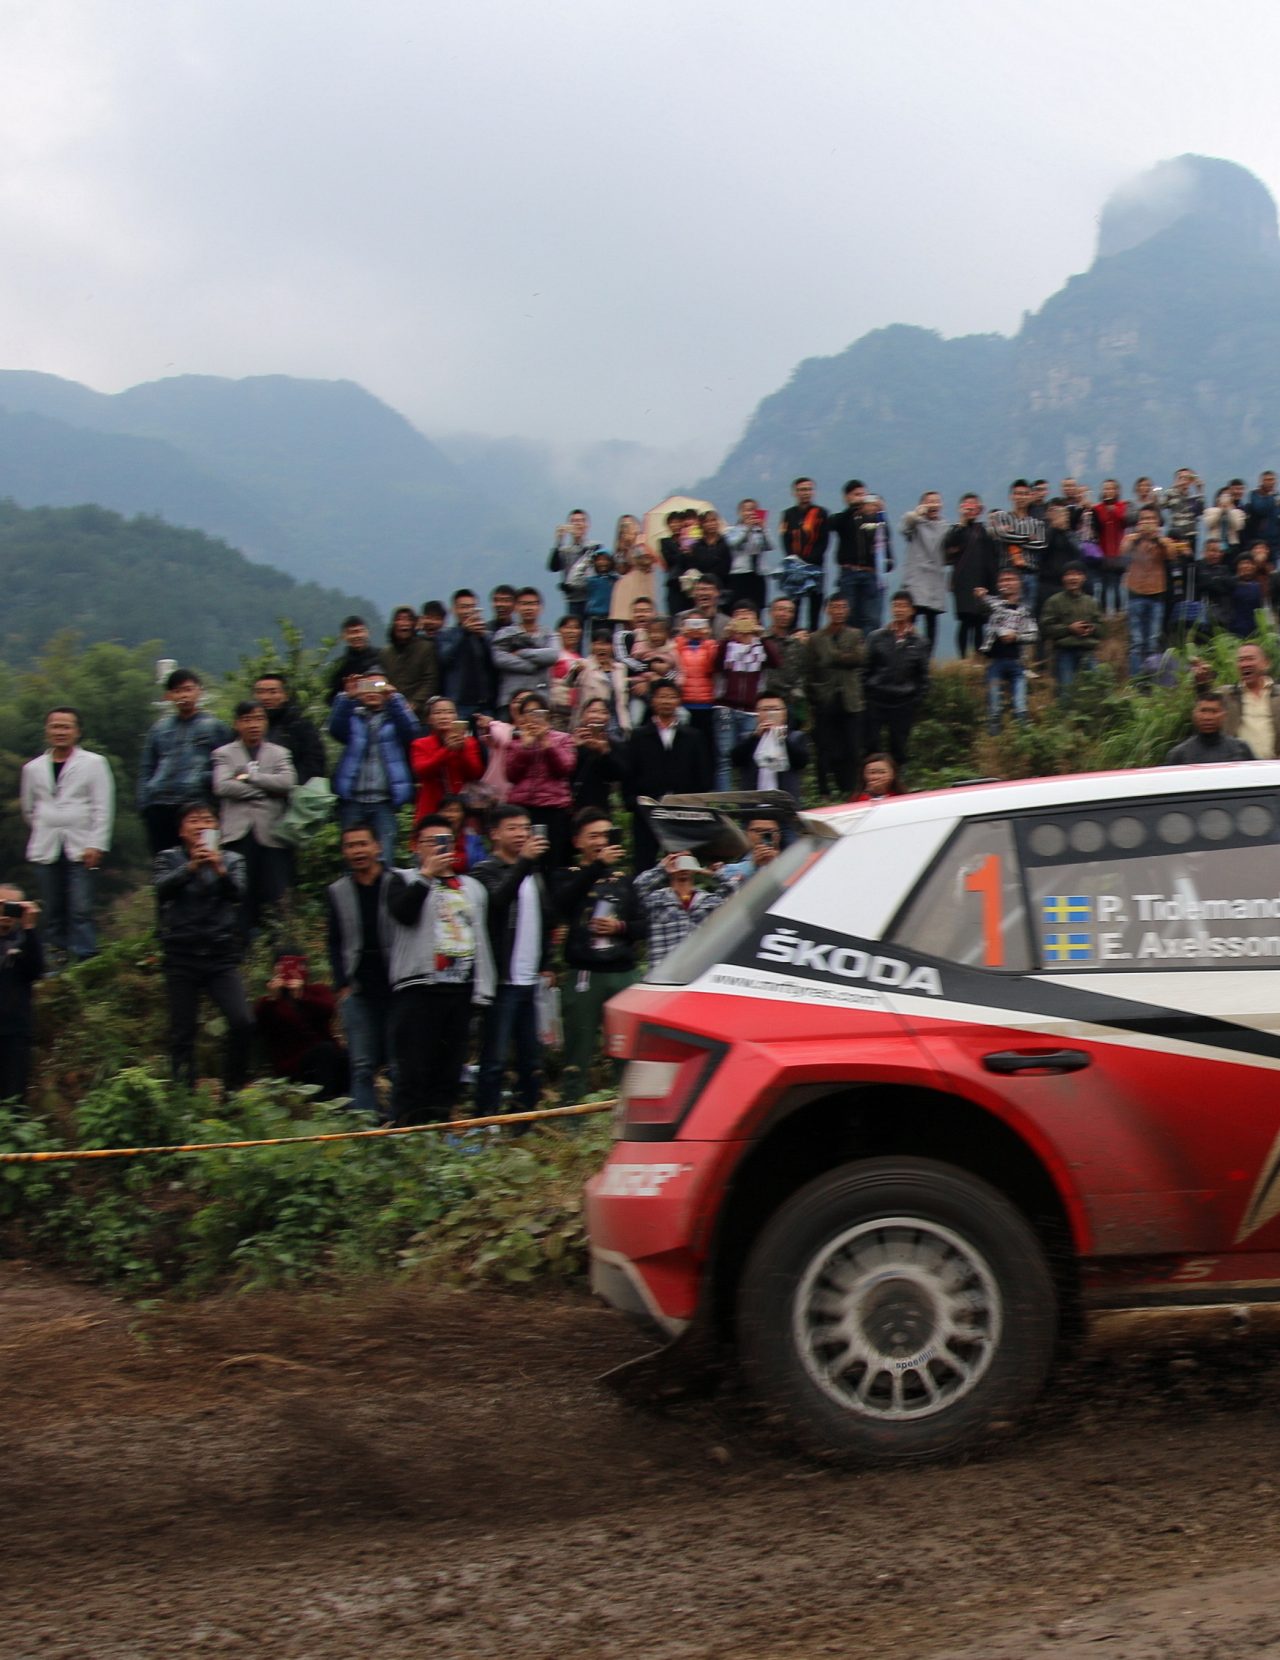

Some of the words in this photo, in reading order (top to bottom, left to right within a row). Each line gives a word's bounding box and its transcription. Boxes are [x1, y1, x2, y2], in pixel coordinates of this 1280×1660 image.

[964, 854, 1005, 967] 1
[1097, 895, 1126, 922] P.
[756, 928, 943, 996] ŠKODA
[1102, 933, 1133, 960] E.
